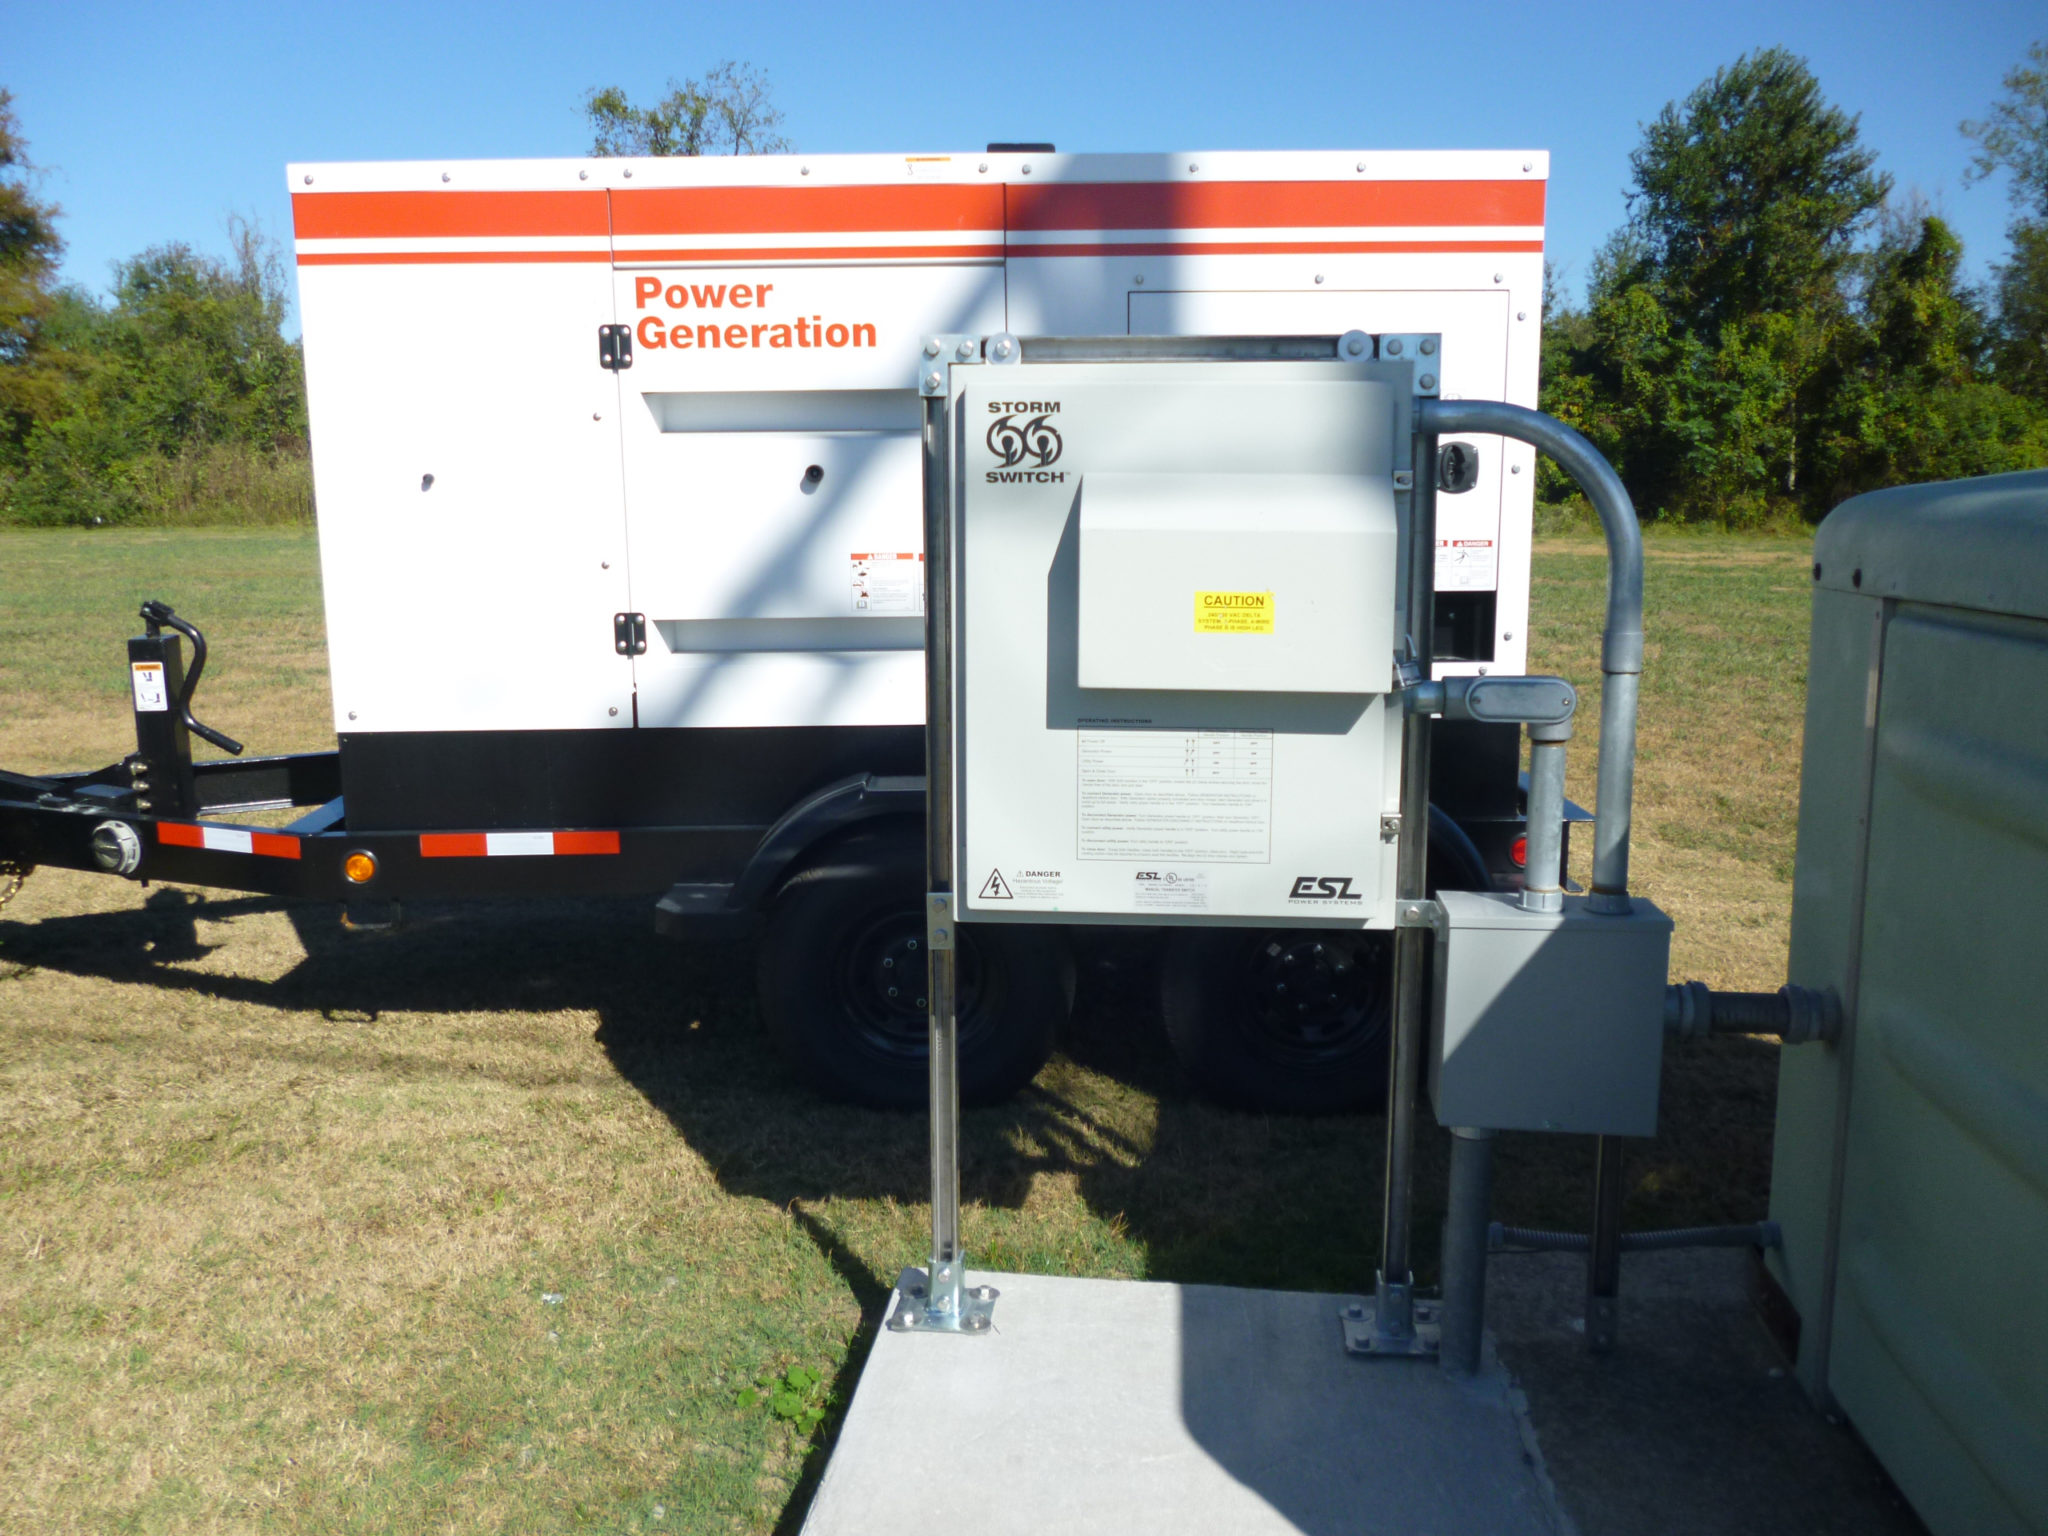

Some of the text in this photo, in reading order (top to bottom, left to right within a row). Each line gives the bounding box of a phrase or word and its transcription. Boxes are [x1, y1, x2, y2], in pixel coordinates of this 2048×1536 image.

[635, 276, 773, 309] Power
[637, 315, 877, 350] Generation
[987, 401, 1061, 414] STORM
[985, 471, 1065, 484] SWITCH
[1204, 594, 1265, 606] CAUTION
[1135, 871, 1162, 880] ESL
[1288, 876, 1363, 899] ESL
